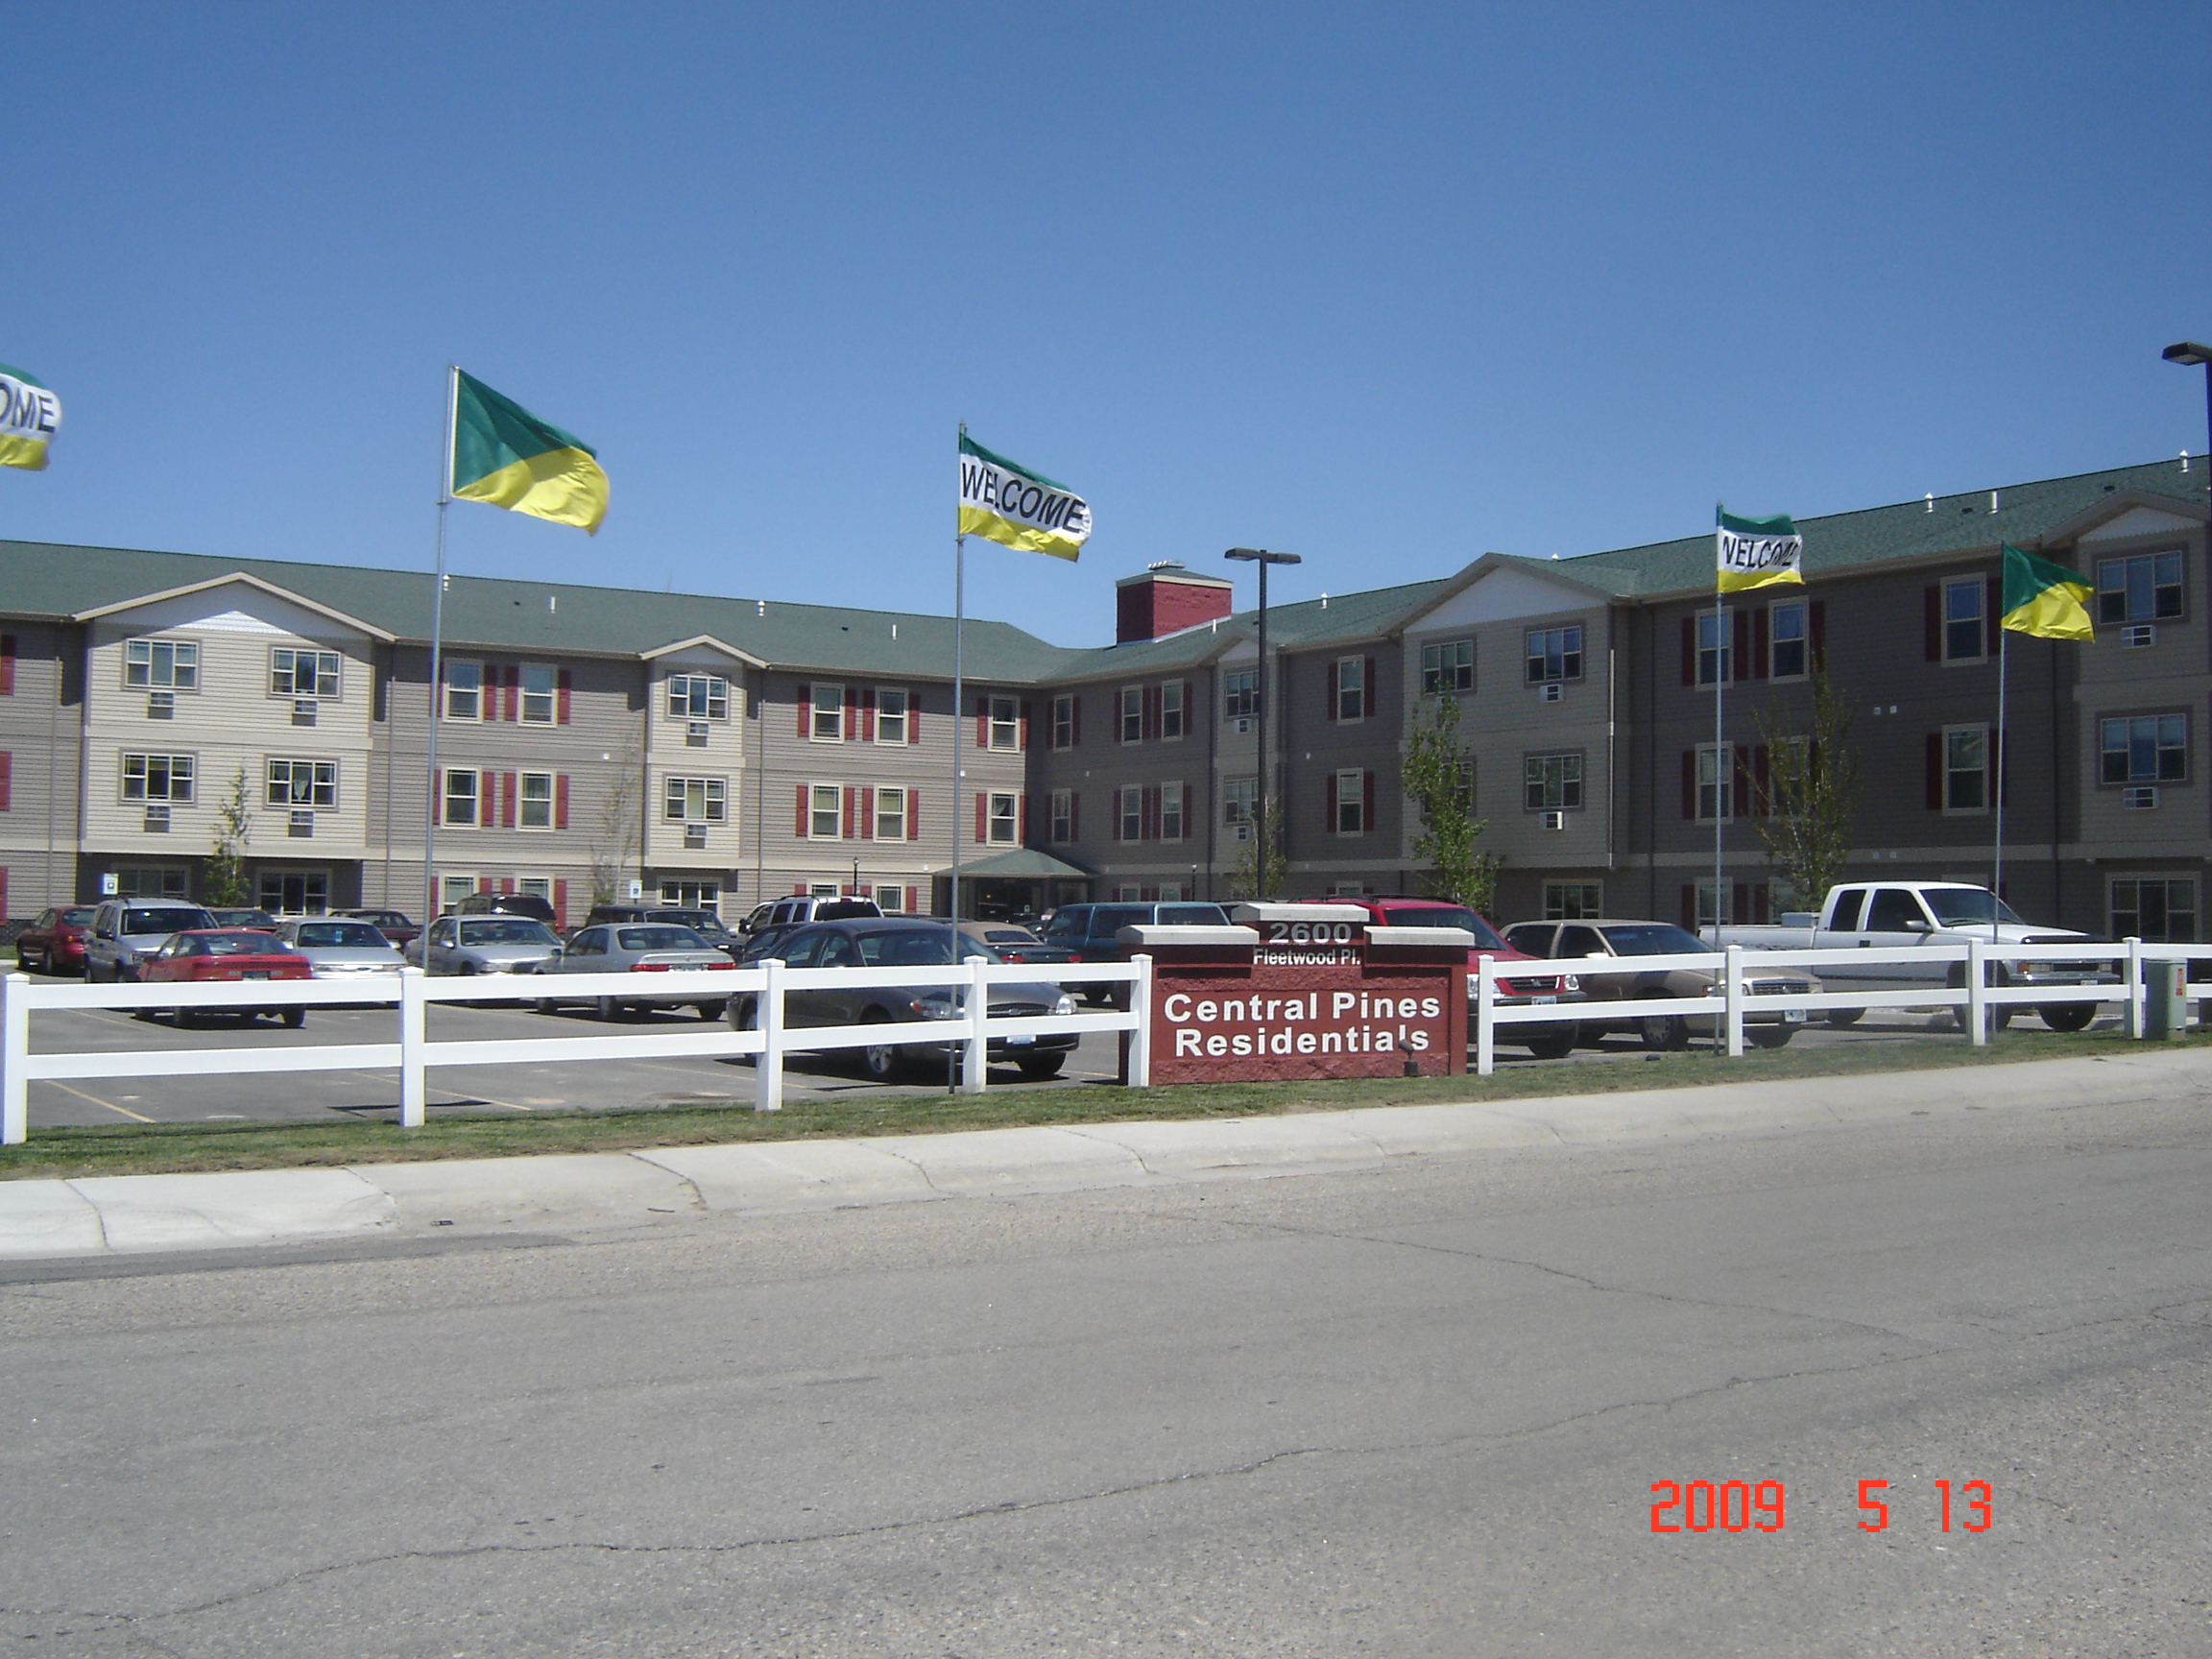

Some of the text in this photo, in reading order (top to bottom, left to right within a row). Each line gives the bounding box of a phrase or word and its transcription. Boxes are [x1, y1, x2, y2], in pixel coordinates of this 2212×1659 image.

[962, 463, 1086, 534] WELCOME
[1268, 922, 1352, 945] 2600
[1253, 948, 1360, 966] Fleetwood Pl.
[1164, 992, 1440, 1022] Central Pines
[1175, 1024, 1430, 1057] Residentials
